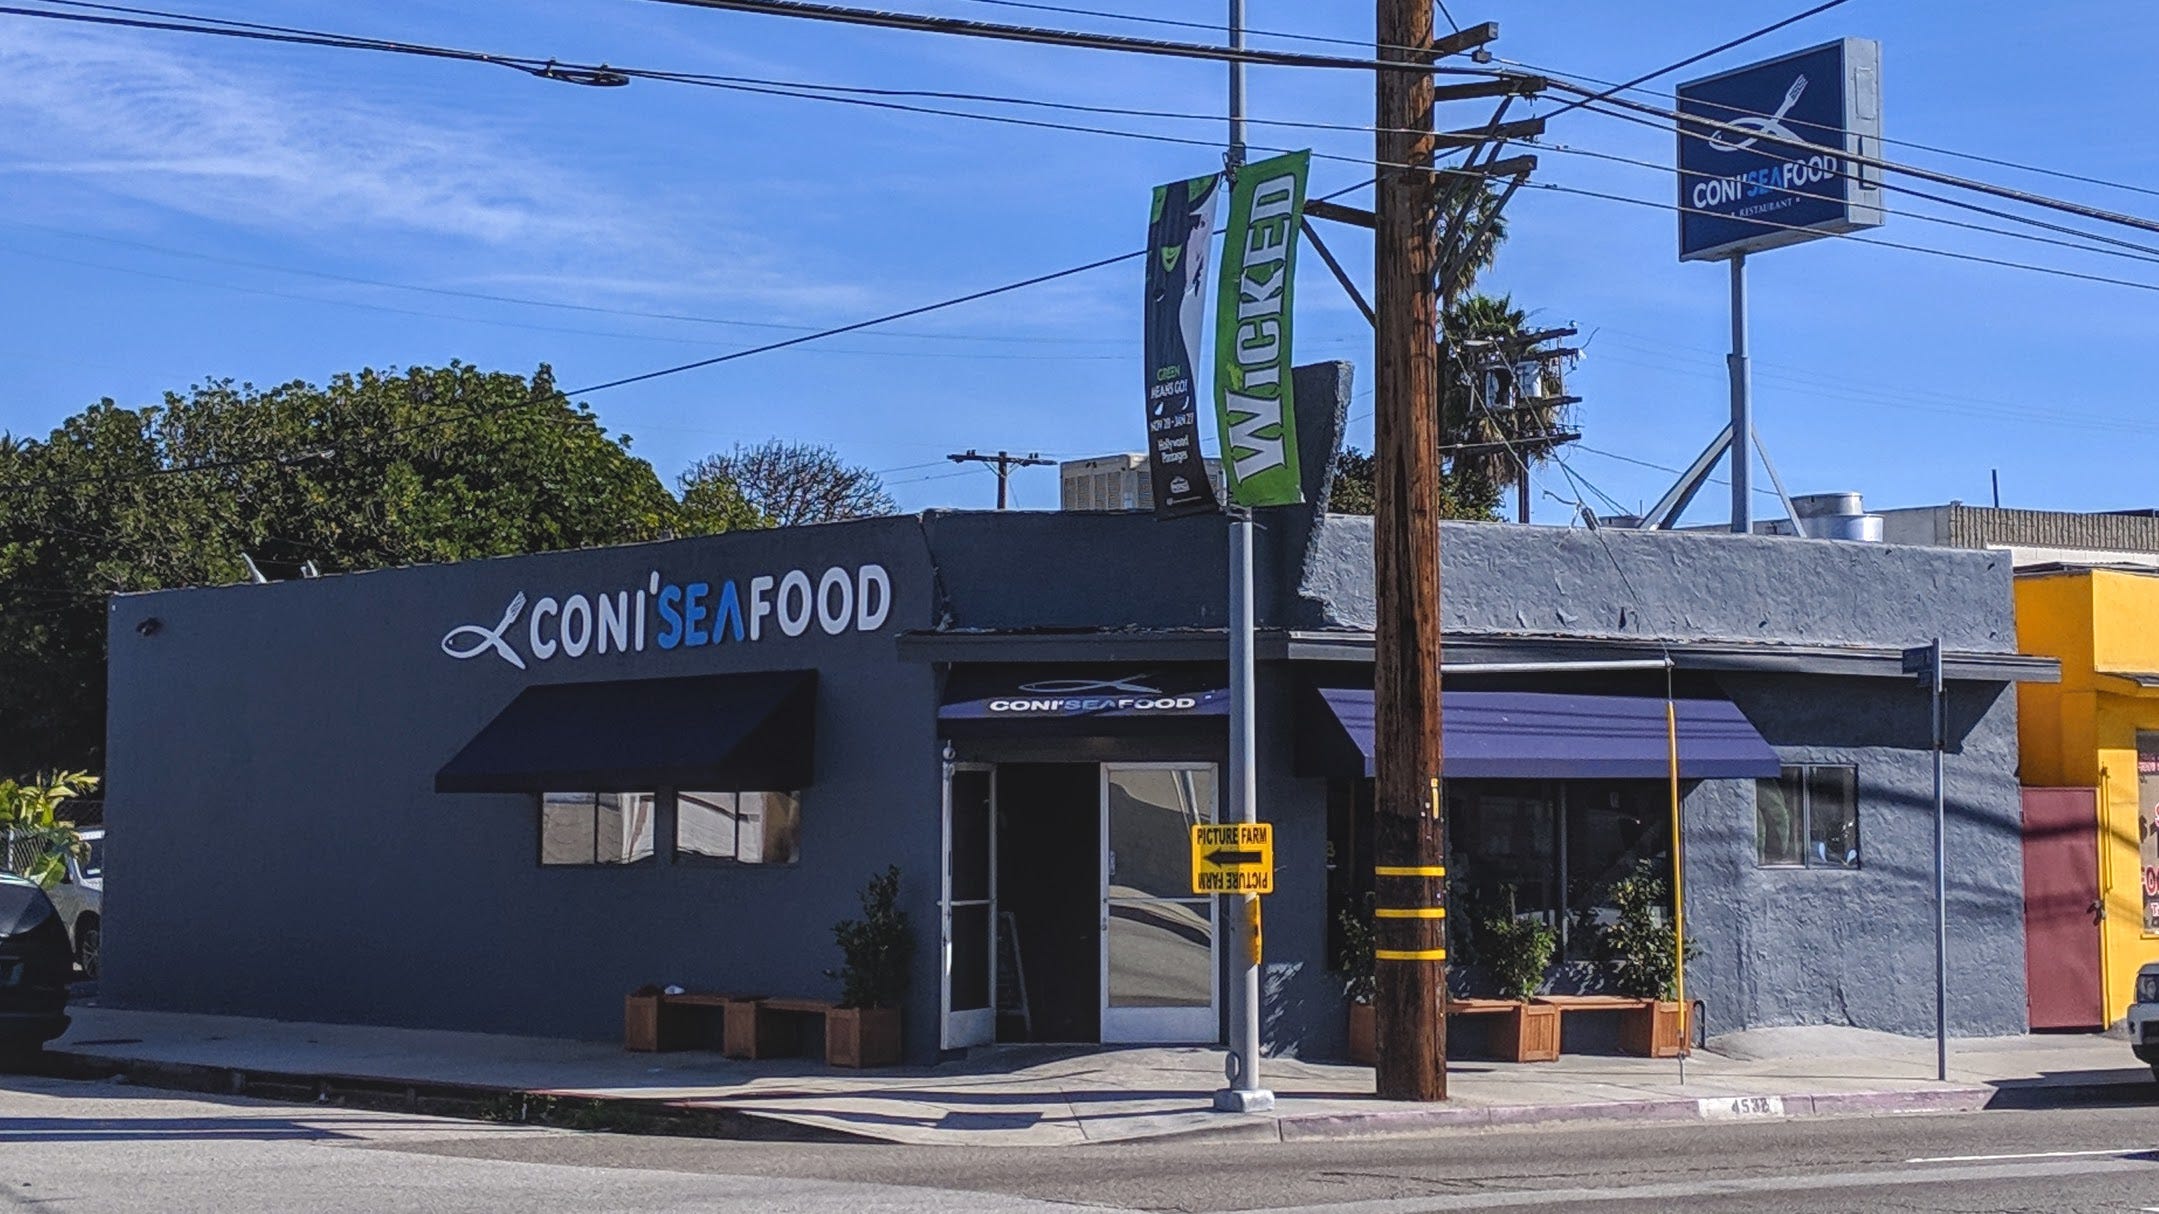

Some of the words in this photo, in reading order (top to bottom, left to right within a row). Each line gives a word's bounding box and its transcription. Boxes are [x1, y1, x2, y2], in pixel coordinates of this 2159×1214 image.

[1693, 154, 1838, 209] CONI'SEAFOOD
[1740, 197, 1793, 218] RESTAURANT
[1225, 172, 1297, 485] WICKED
[1156, 364, 1181, 381] GREEN
[1158, 434, 1189, 452] Hollywood
[530, 563, 891, 660] CONI'SEAFOOD
[1197, 827, 1239, 845] PICTURE
[1241, 827, 1267, 844] FARM
[1198, 872, 1224, 889] FARM
[1226, 872, 1268, 889] PICTURE
